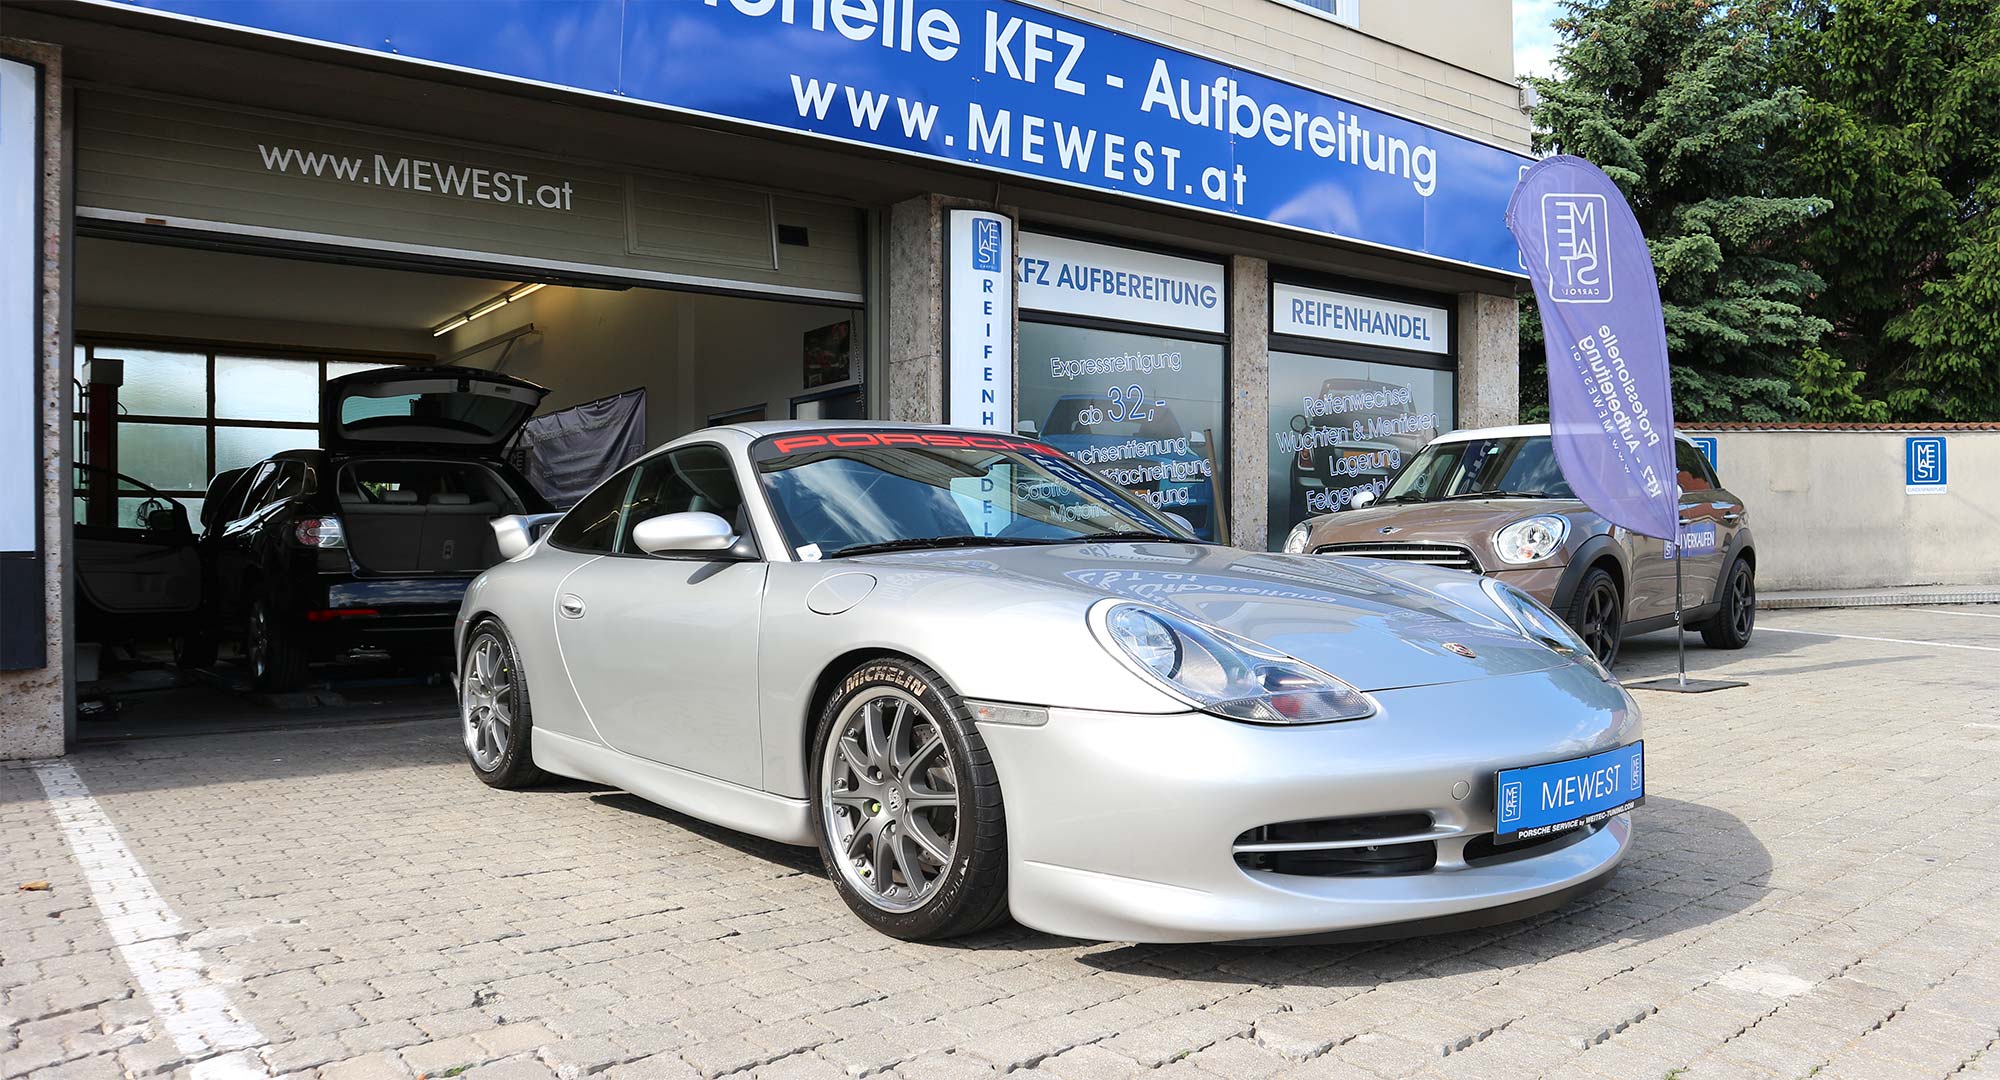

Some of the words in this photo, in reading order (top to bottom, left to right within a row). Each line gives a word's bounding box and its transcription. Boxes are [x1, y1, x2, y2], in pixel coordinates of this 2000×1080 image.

[984, 10, 1087, 96] KFZ
[1106, 74, 1124, 89] -
[1140, 58, 1437, 197] Aufbereitung
[790, 74, 1247, 205] www.MEWEST.at
[257, 143, 573, 211] www.MEWEST.at
[1056, 263, 1218, 310] AUFBEREITUNG
[1291, 297, 1431, 342] REIFENHANDEL
[1050, 352, 1183, 380] Expressreinigung
[1078, 405, 1104, 426] ab
[1303, 382, 1413, 418] Reifenwechsel
[773, 432, 1073, 462] PORSCHE
[1275, 426, 1349, 454] Wuchten
[1353, 420, 1365, 442] &
[1366, 412, 1440, 440] Montieren
[1328, 447, 1401, 477] Lagerung
[845, 665, 928, 697] MICHELIN
[1541, 764, 1622, 811] MEWEST
[1518, 827, 1551, 839] PORSCHE
[1552, 820, 1579, 833] SERVICE
